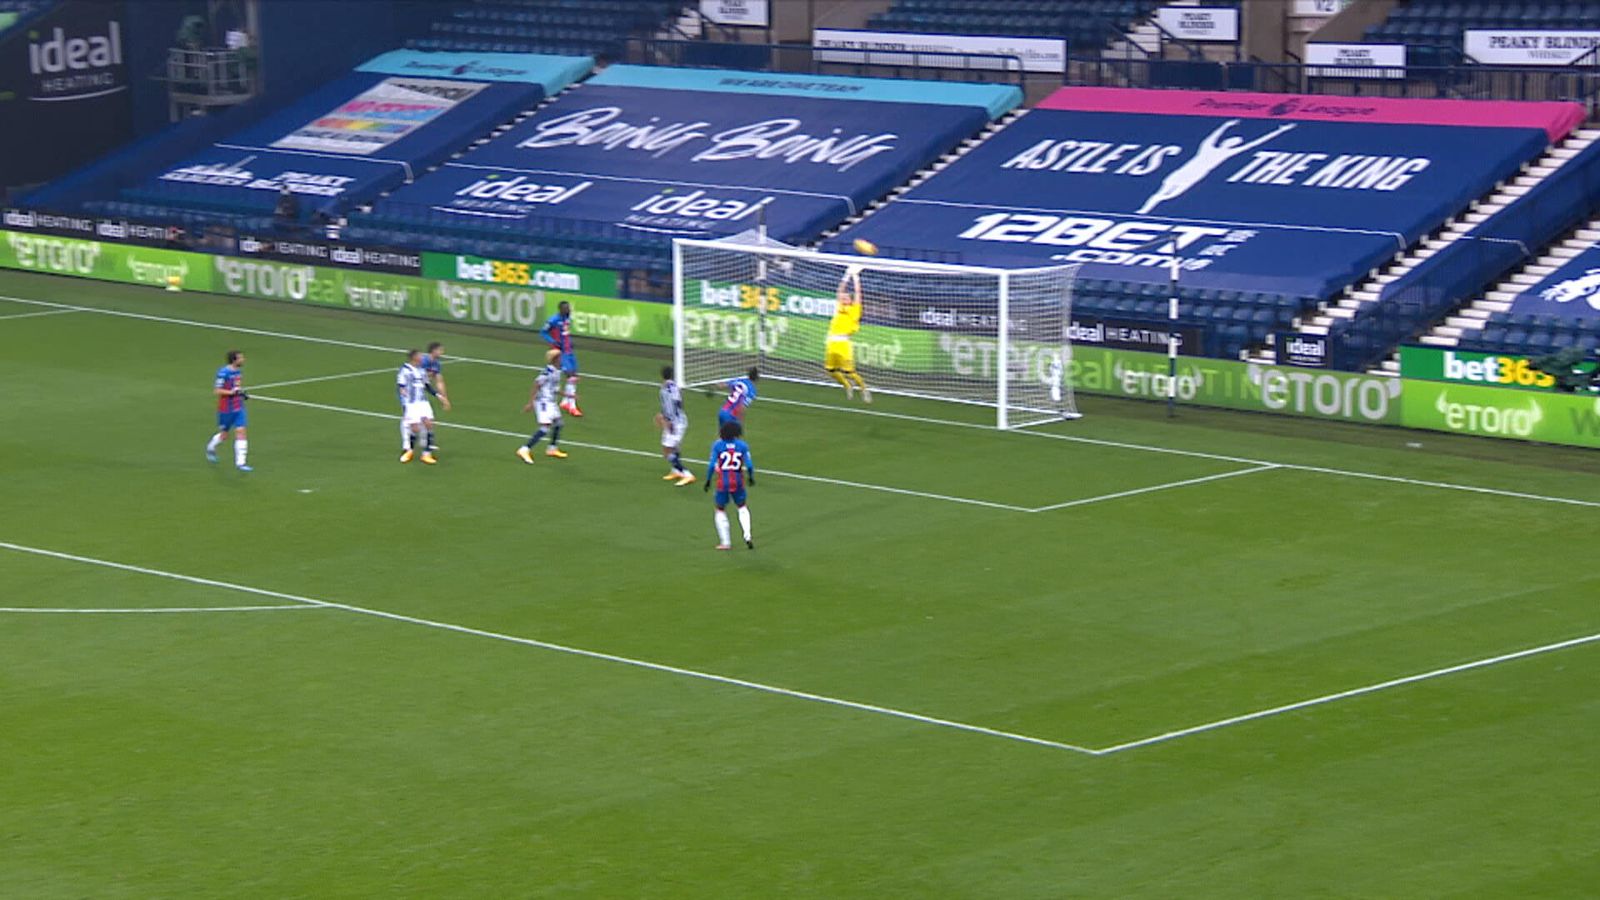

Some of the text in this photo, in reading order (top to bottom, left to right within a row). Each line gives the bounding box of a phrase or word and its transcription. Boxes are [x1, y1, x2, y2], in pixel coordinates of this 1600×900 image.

[28, 20, 122, 74] ideal
[1488, 35, 1540, 49] PEAKY
[1001, 139, 1182, 176] ASTLE IS
[1226, 151, 1431, 191] THE KING
[455, 174, 593, 205] ideal
[631, 188, 775, 221] ideal
[957, 213, 1230, 255] 12BET
[456, 255, 580, 291] bet365.com
[720, 451, 742, 470] 25
